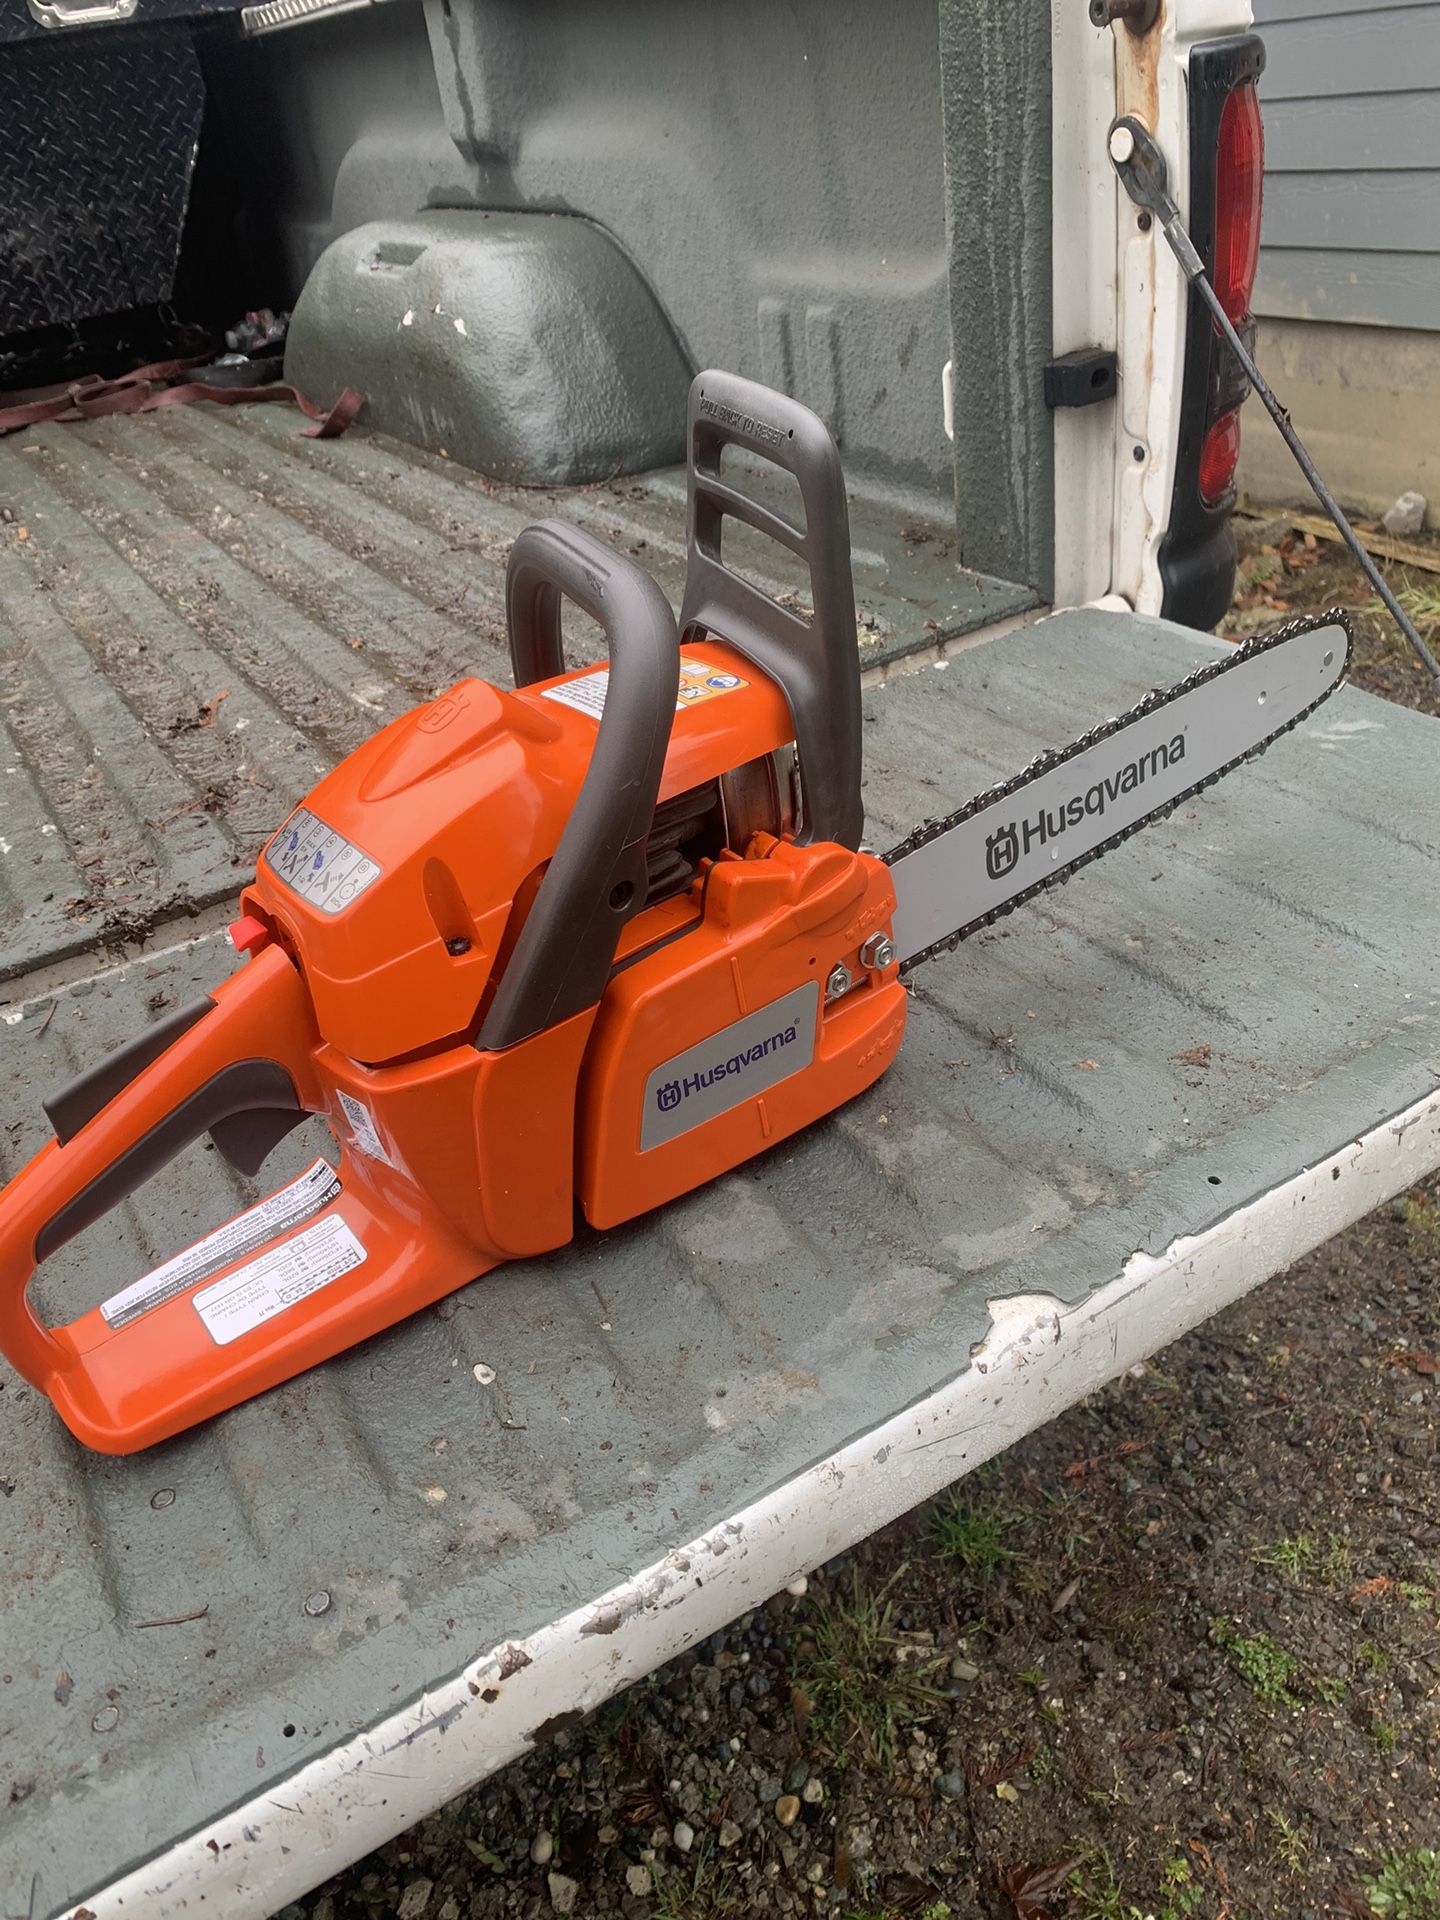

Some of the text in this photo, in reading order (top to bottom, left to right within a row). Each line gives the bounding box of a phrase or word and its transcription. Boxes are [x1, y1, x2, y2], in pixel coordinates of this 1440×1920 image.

[720, 405, 743, 429] BACK
[743, 415, 755, 434] TO
[755, 420, 787, 447] RESET
[1022, 734, 1185, 855] Husqvarna
[683, 1026, 797, 1097] Husqvarna
[280, 1190, 333, 1230] Husqvarna
